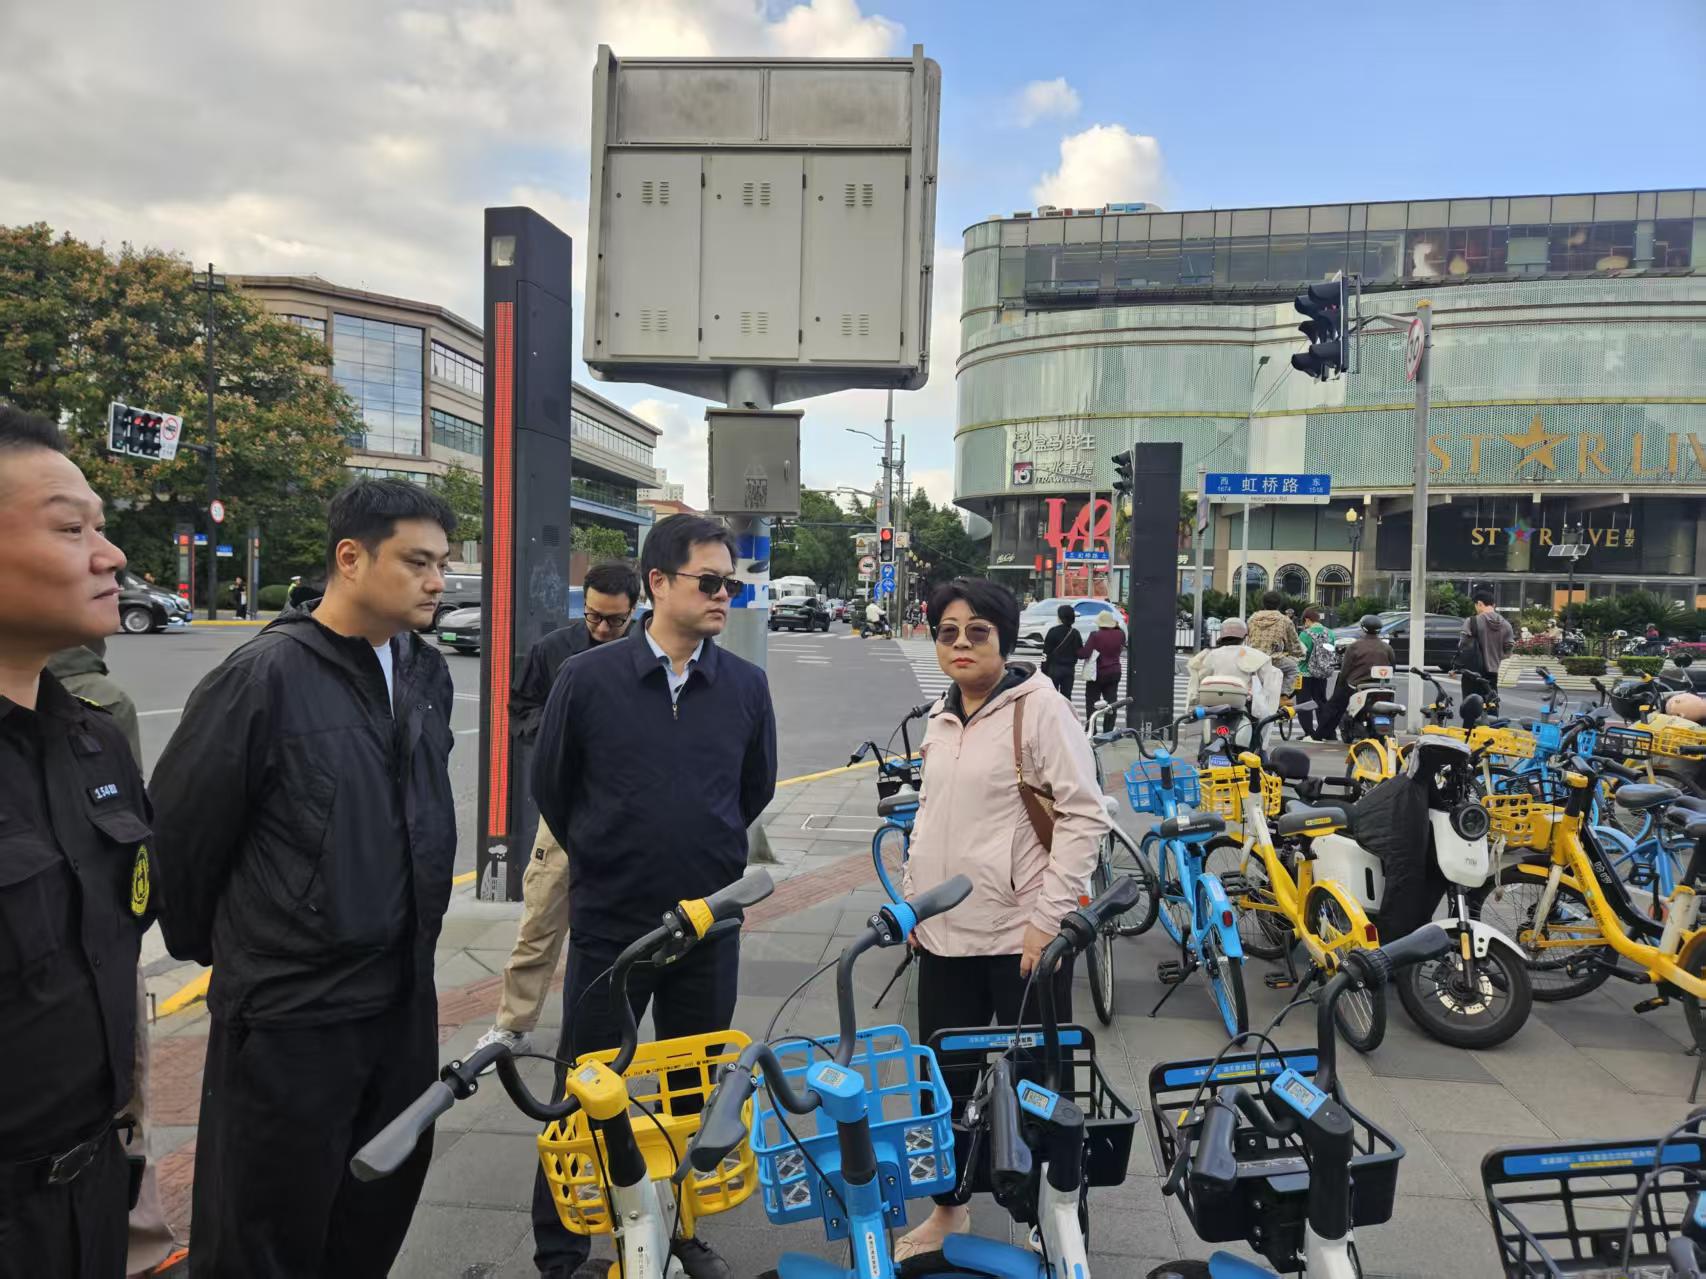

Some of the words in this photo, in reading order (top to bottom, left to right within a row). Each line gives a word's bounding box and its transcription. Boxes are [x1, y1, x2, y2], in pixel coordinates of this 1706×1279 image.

[1034, 432, 1096, 452] 盒马鲜生
[1241, 476, 1299, 493] 虹桥路
